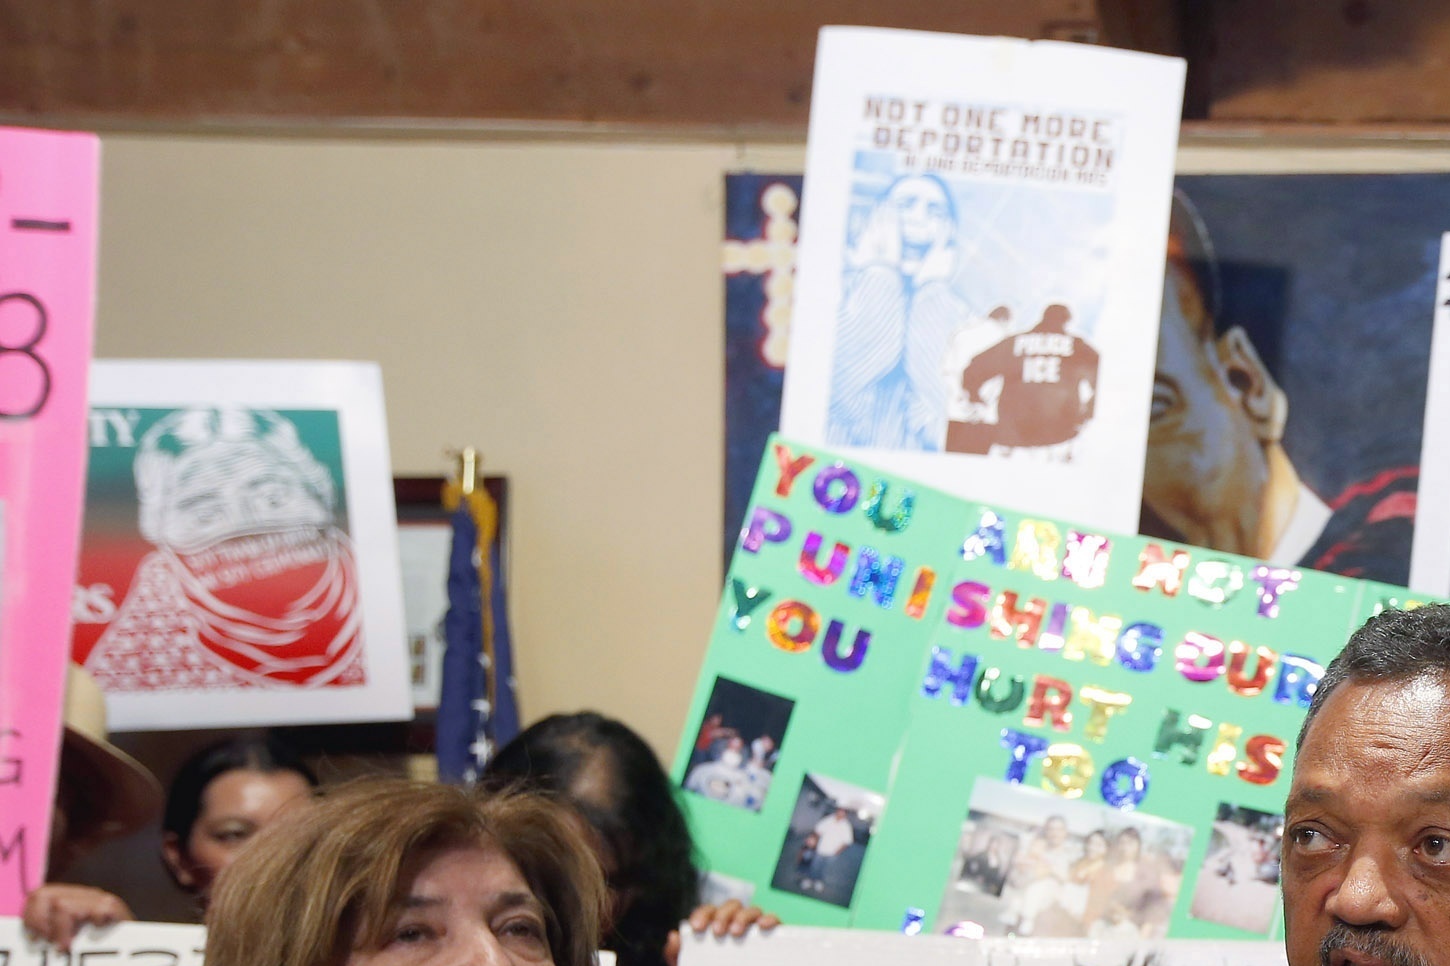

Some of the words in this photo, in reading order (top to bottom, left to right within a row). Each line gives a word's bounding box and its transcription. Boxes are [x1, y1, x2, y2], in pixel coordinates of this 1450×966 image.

[864, 97, 926, 122] NOT
[941, 105, 1006, 131] ONE
[1022, 114, 1112, 142] MORE
[874, 126, 1115, 169] DEPORTATION
[1022, 356, 1061, 383] ICE
[774, 443, 917, 534] YOU
[727, 577, 872, 673] YOU
[921, 645, 1133, 743] HURT
[1152, 707, 1286, 786] HIS
[1000, 728, 1150, 813] TOO
